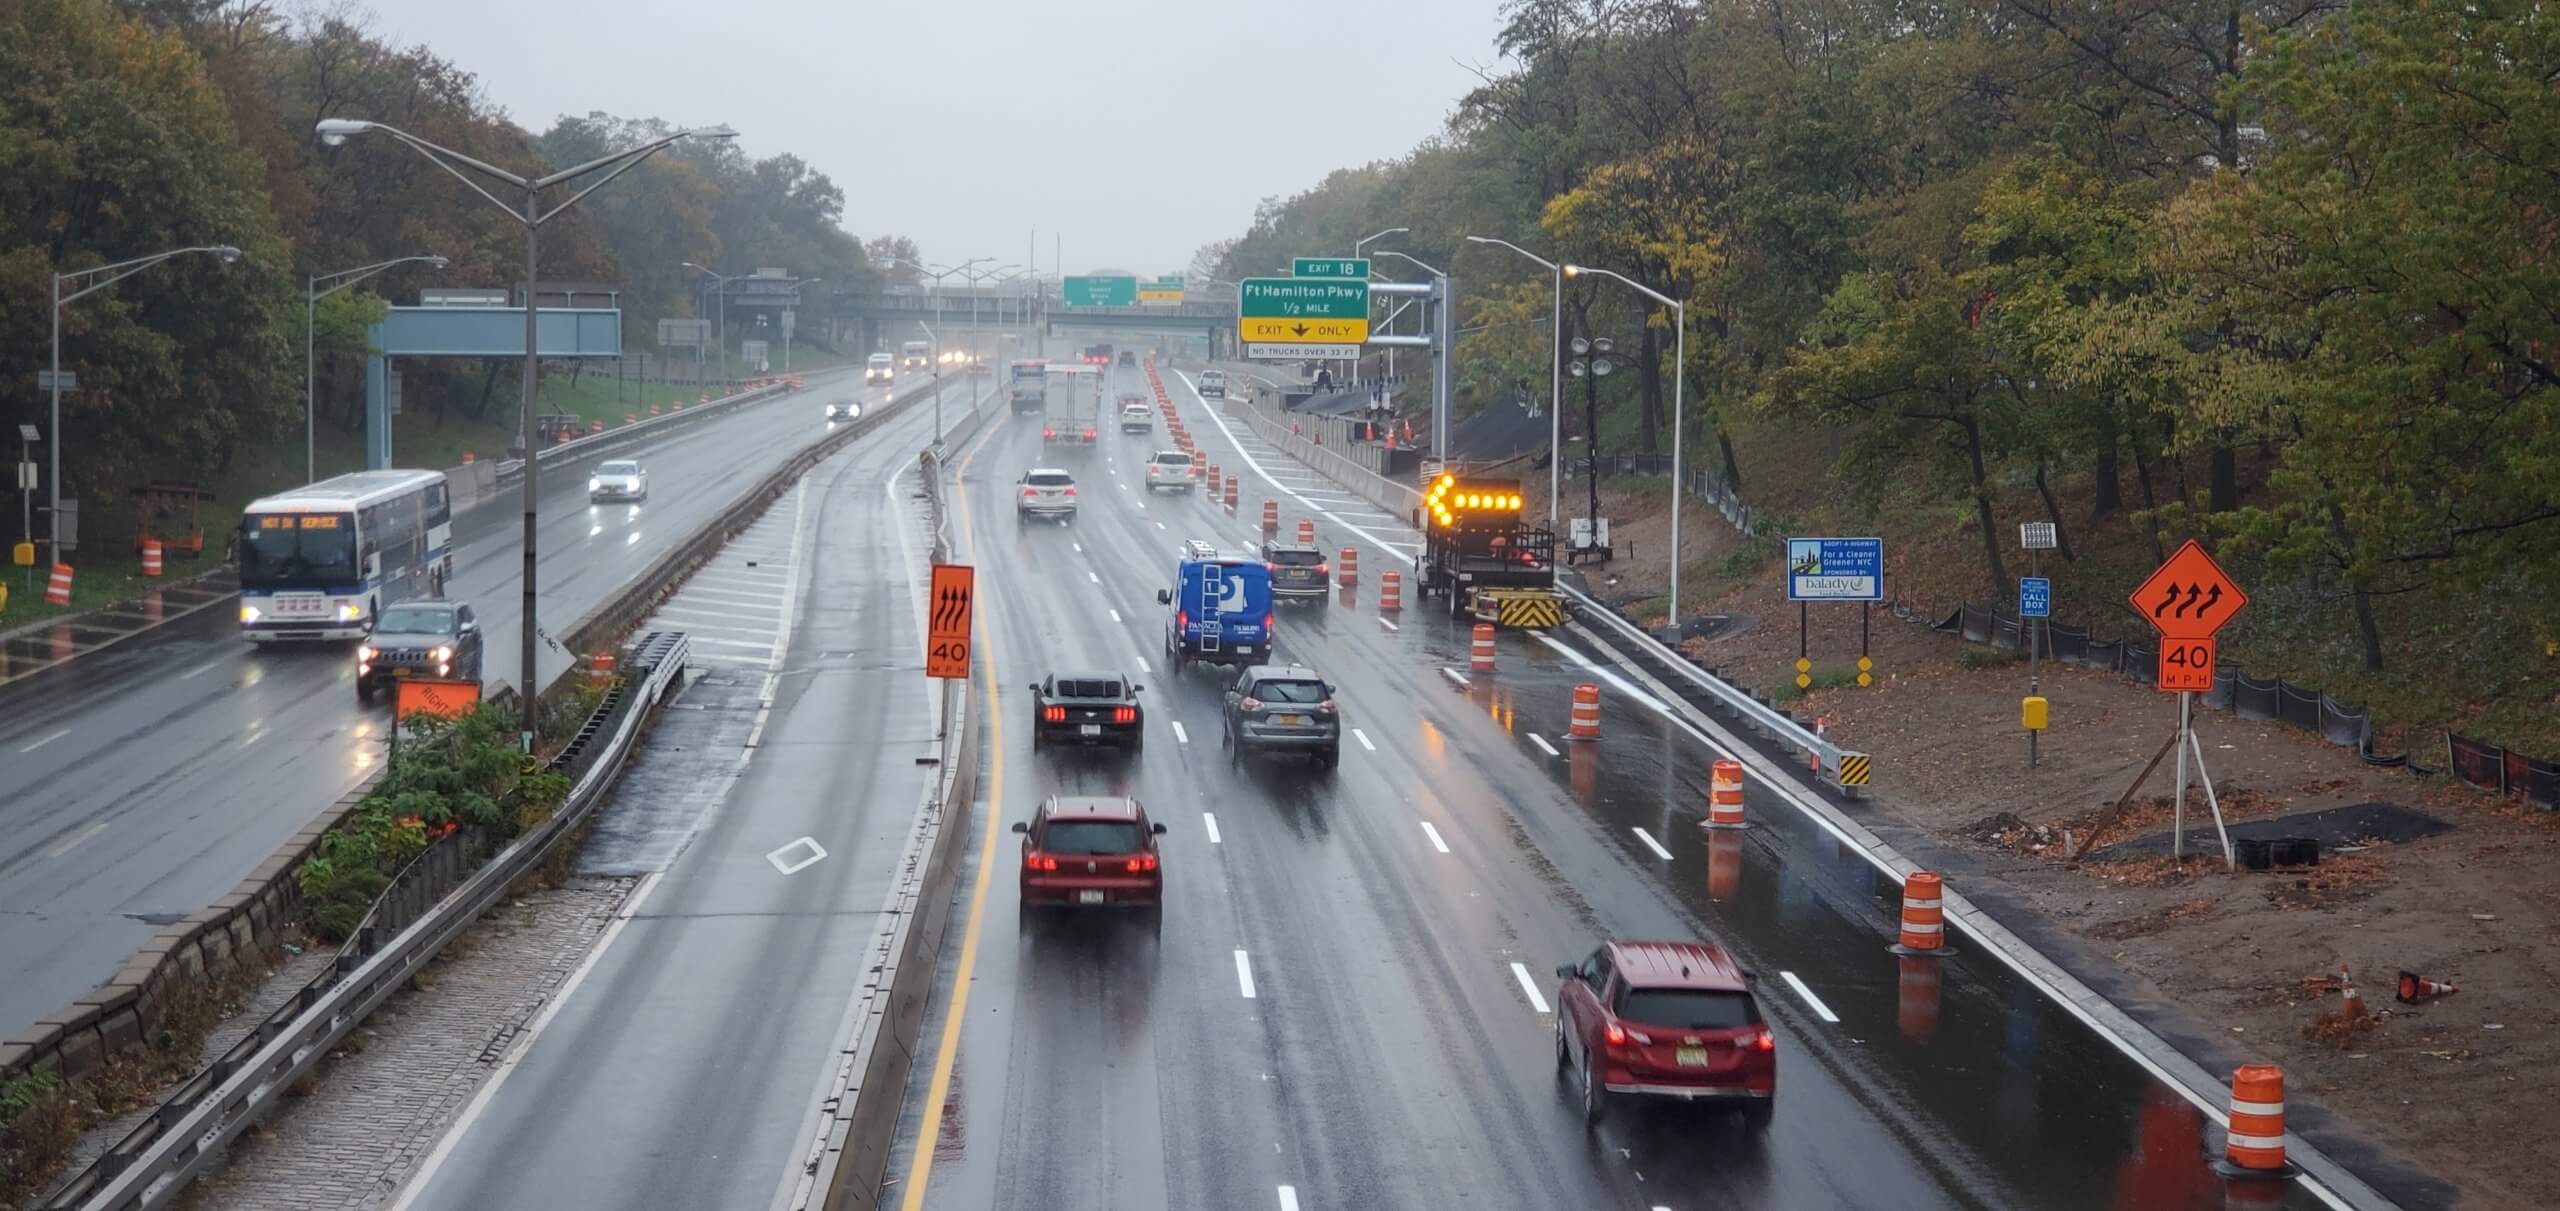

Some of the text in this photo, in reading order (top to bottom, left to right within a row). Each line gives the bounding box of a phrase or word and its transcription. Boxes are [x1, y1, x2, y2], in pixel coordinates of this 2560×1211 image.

[1308, 263, 1354, 276] EXIT 18
[1246, 285, 1364, 299] Ft Hamilton Pkwy
[1306, 303, 1330, 313] MILE
[1257, 325, 1351, 335] EXIT ONLY
[1252, 348, 1264, 356] NO
[1268, 348, 1300, 356] TRUCKS
[1304, 348, 1326, 356] OVER
[261, 516, 279, 529] NOT
[300, 516, 339, 529] SERVICE
[1846, 550, 1877, 558] Cleaner
[1806, 577, 1848, 592] balady
[2023, 593, 2047, 602] CALL
[2025, 601, 2044, 609] BOX
[932, 642, 966, 662] 40
[2167, 645, 2209, 669] 40
[421, 686, 449, 713] RIGHT
